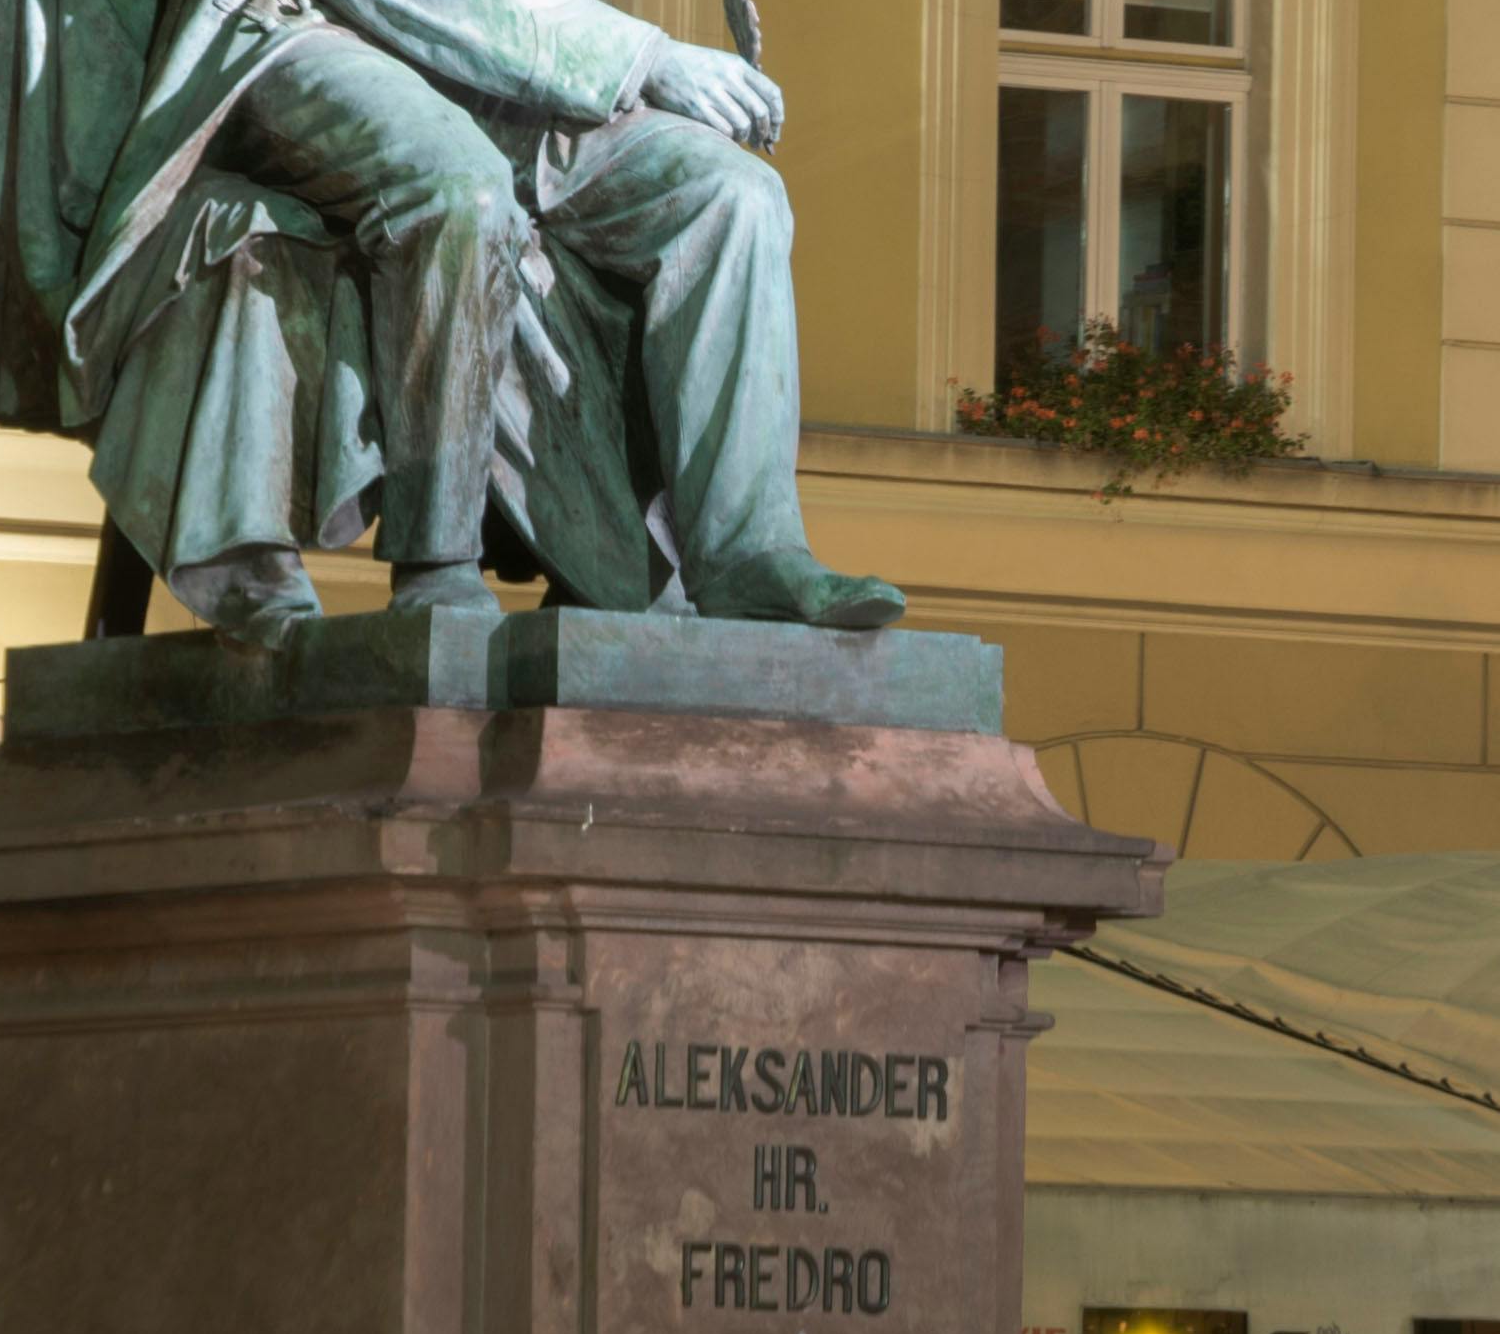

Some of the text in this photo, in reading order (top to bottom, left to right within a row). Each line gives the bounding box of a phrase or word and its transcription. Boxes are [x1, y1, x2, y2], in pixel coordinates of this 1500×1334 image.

[615, 1039, 950, 1122] ALEKSANDER
[752, 1144, 829, 1213] HR.
[680, 1241, 892, 1316] FREDRO
